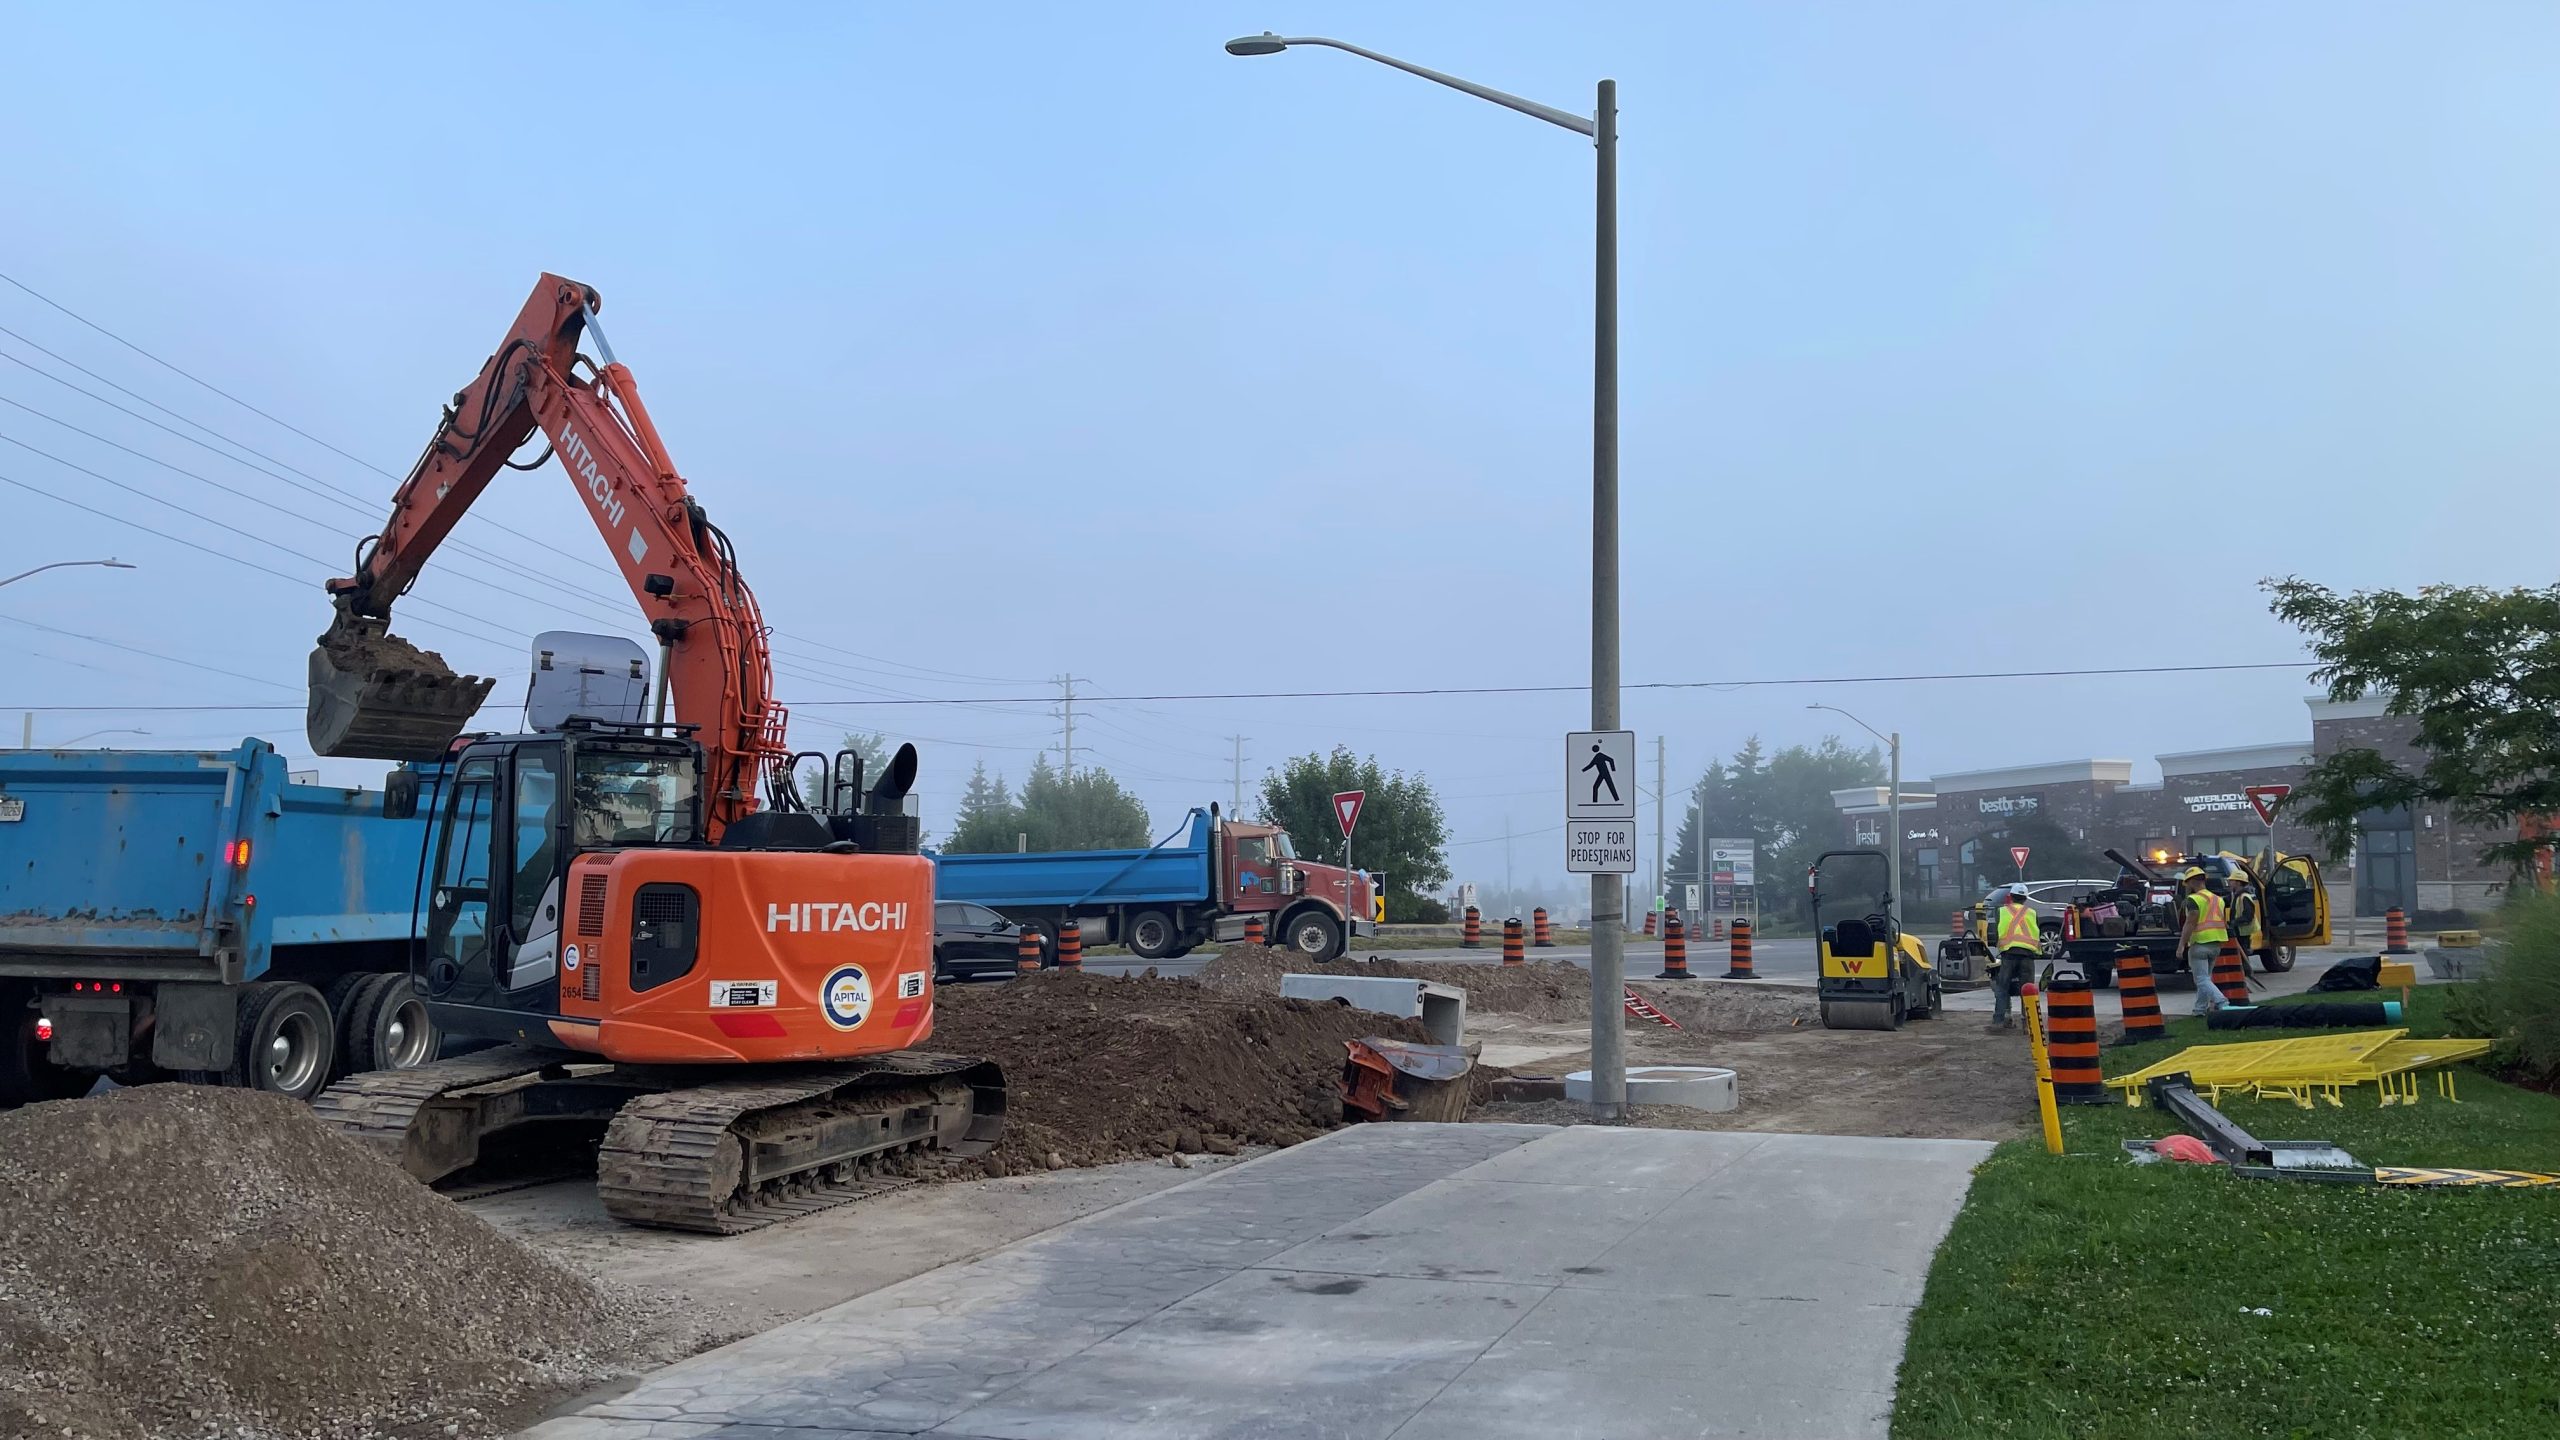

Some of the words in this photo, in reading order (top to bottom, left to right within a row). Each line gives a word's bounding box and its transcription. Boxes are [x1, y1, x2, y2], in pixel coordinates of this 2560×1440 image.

[560, 421, 625, 528] HITACHI
[2183, 793, 2237, 804] WATERLOO
[2191, 801, 2252, 812] OPTOMETR
[1577, 831, 1600, 845] STOP
[1607, 831, 1625, 845] FOR
[1571, 848, 1631, 862] PEDESTRIANS
[767, 902, 907, 932] HITACHI
[562, 986, 581, 999] 2654
